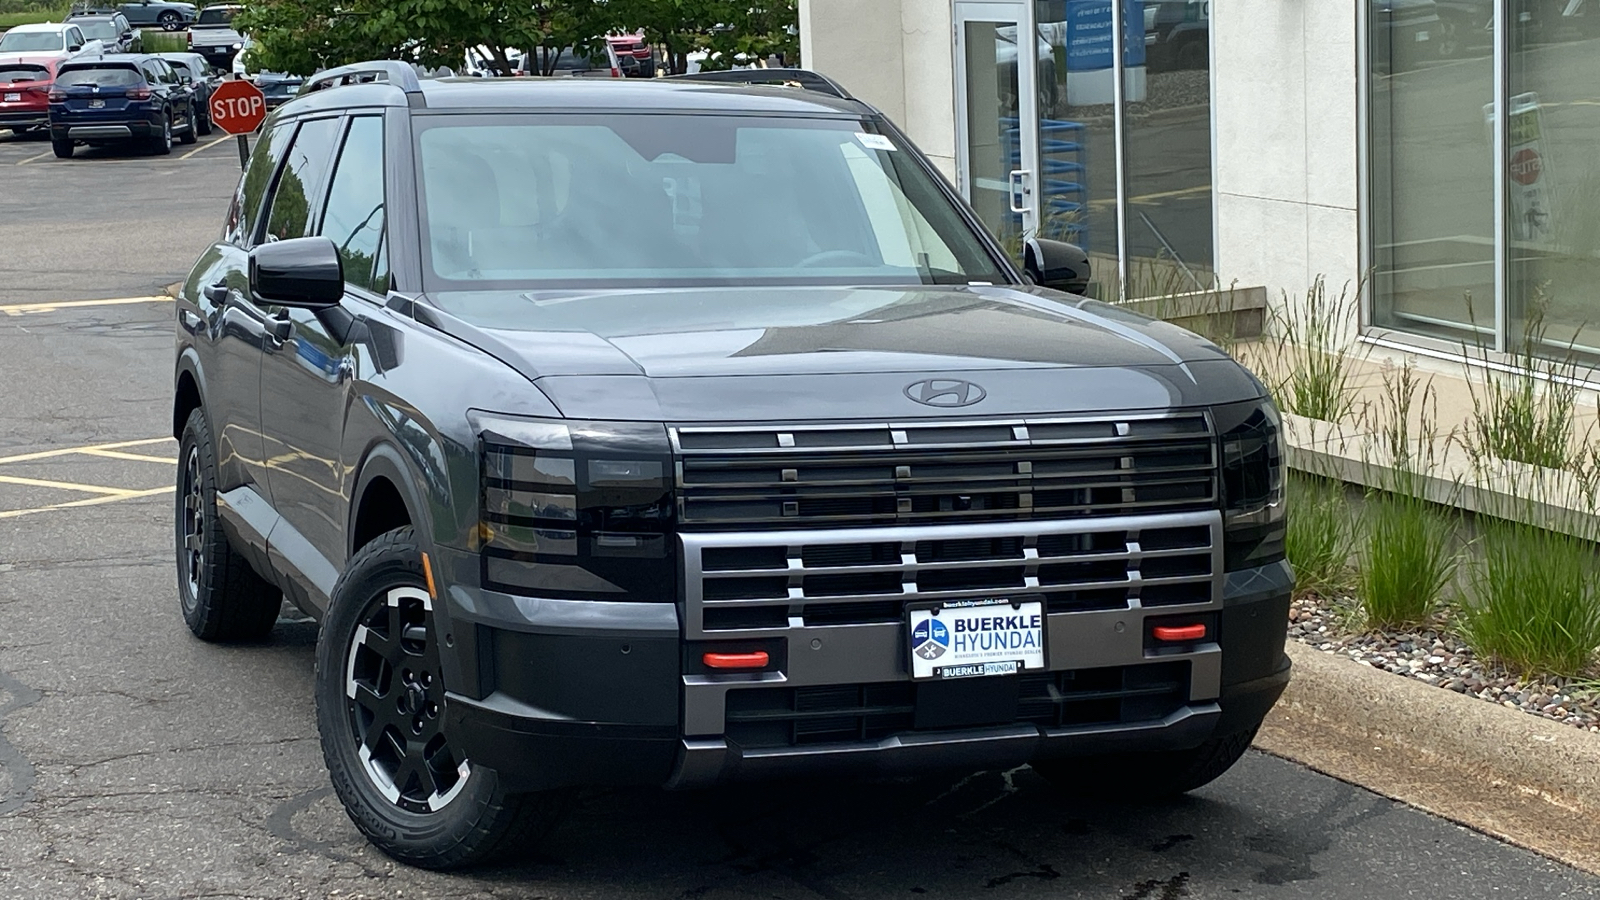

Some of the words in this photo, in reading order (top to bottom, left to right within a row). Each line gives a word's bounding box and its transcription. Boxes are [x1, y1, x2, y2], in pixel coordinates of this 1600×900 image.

[214, 96, 262, 120] STOP
[954, 615, 1041, 633] BUERKLE
[954, 630, 1042, 653] HYUNDAI
[943, 665, 984, 677] BUERKLE
[985, 662, 1015, 673] HYUNDAI
